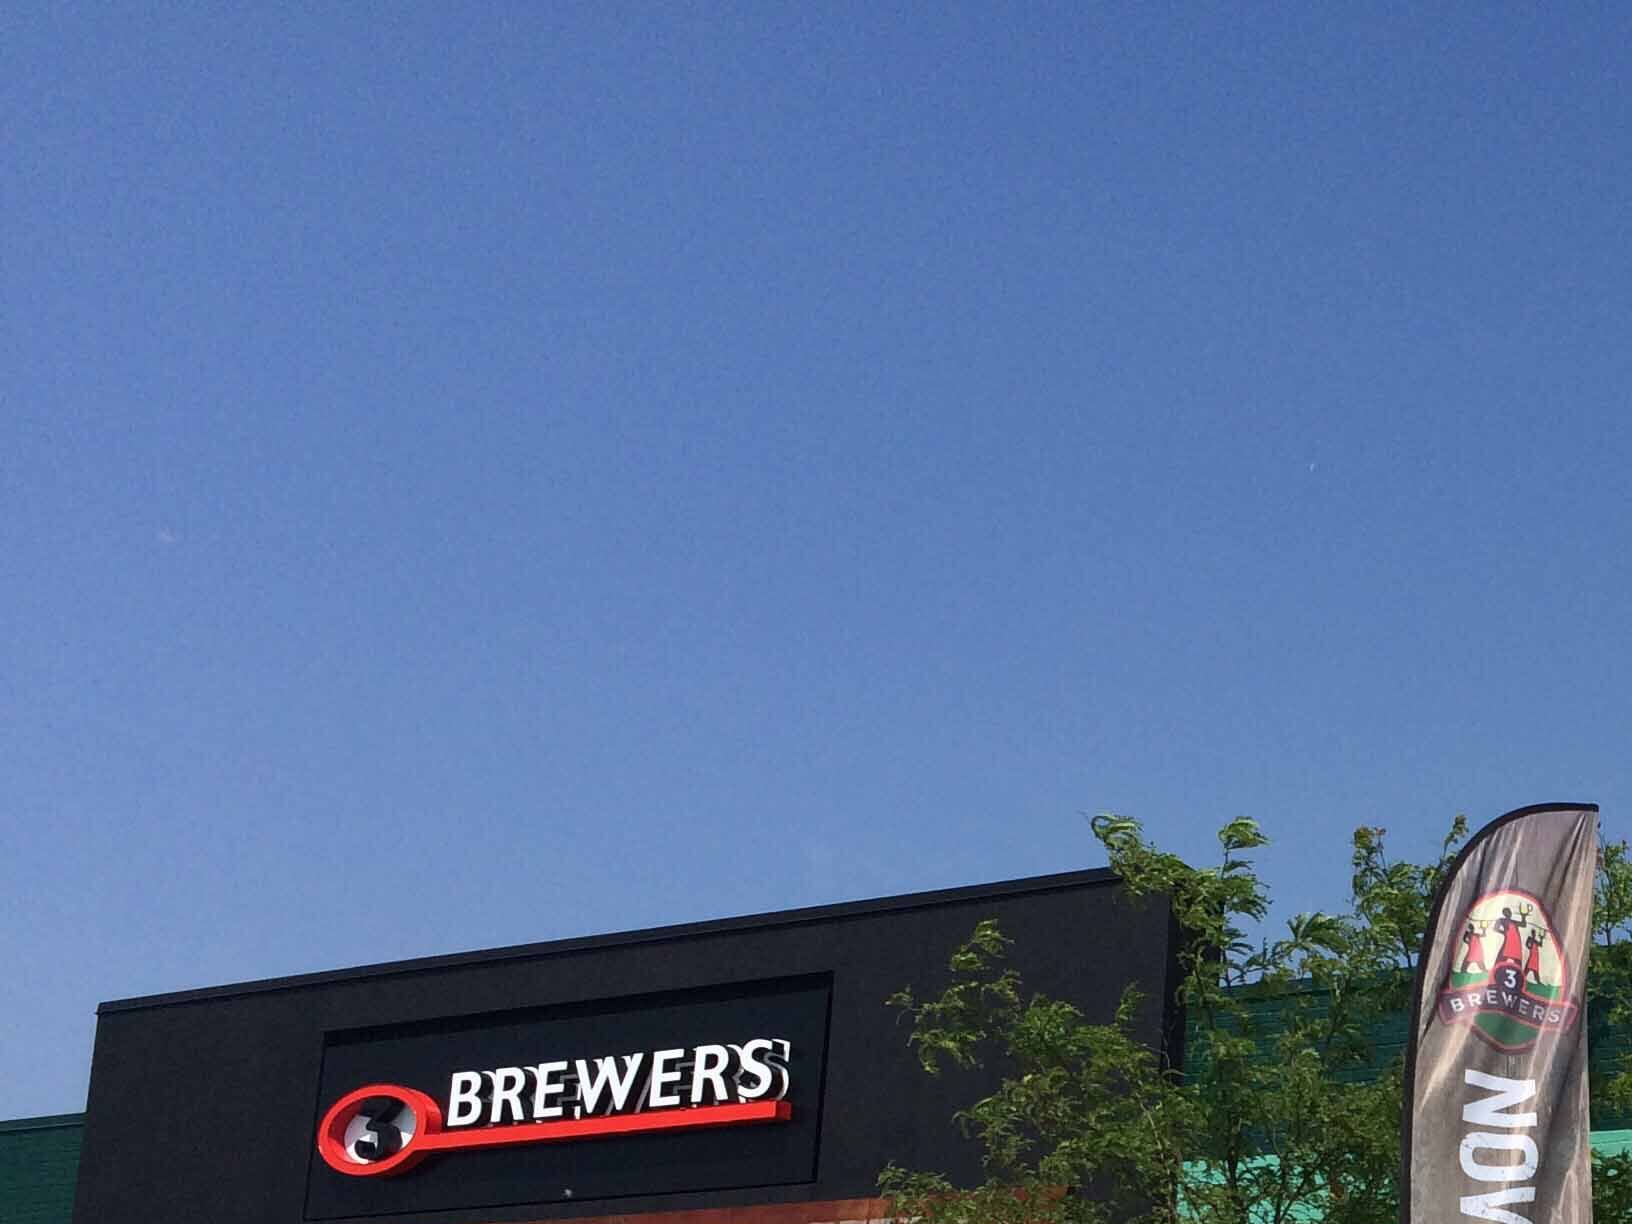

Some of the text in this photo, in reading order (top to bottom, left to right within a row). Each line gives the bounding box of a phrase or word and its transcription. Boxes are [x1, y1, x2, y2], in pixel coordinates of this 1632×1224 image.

[1504, 969, 1519, 989] 3
[1449, 989, 1562, 1024] BREWERS
[446, 1037, 788, 1129] BREWERS
